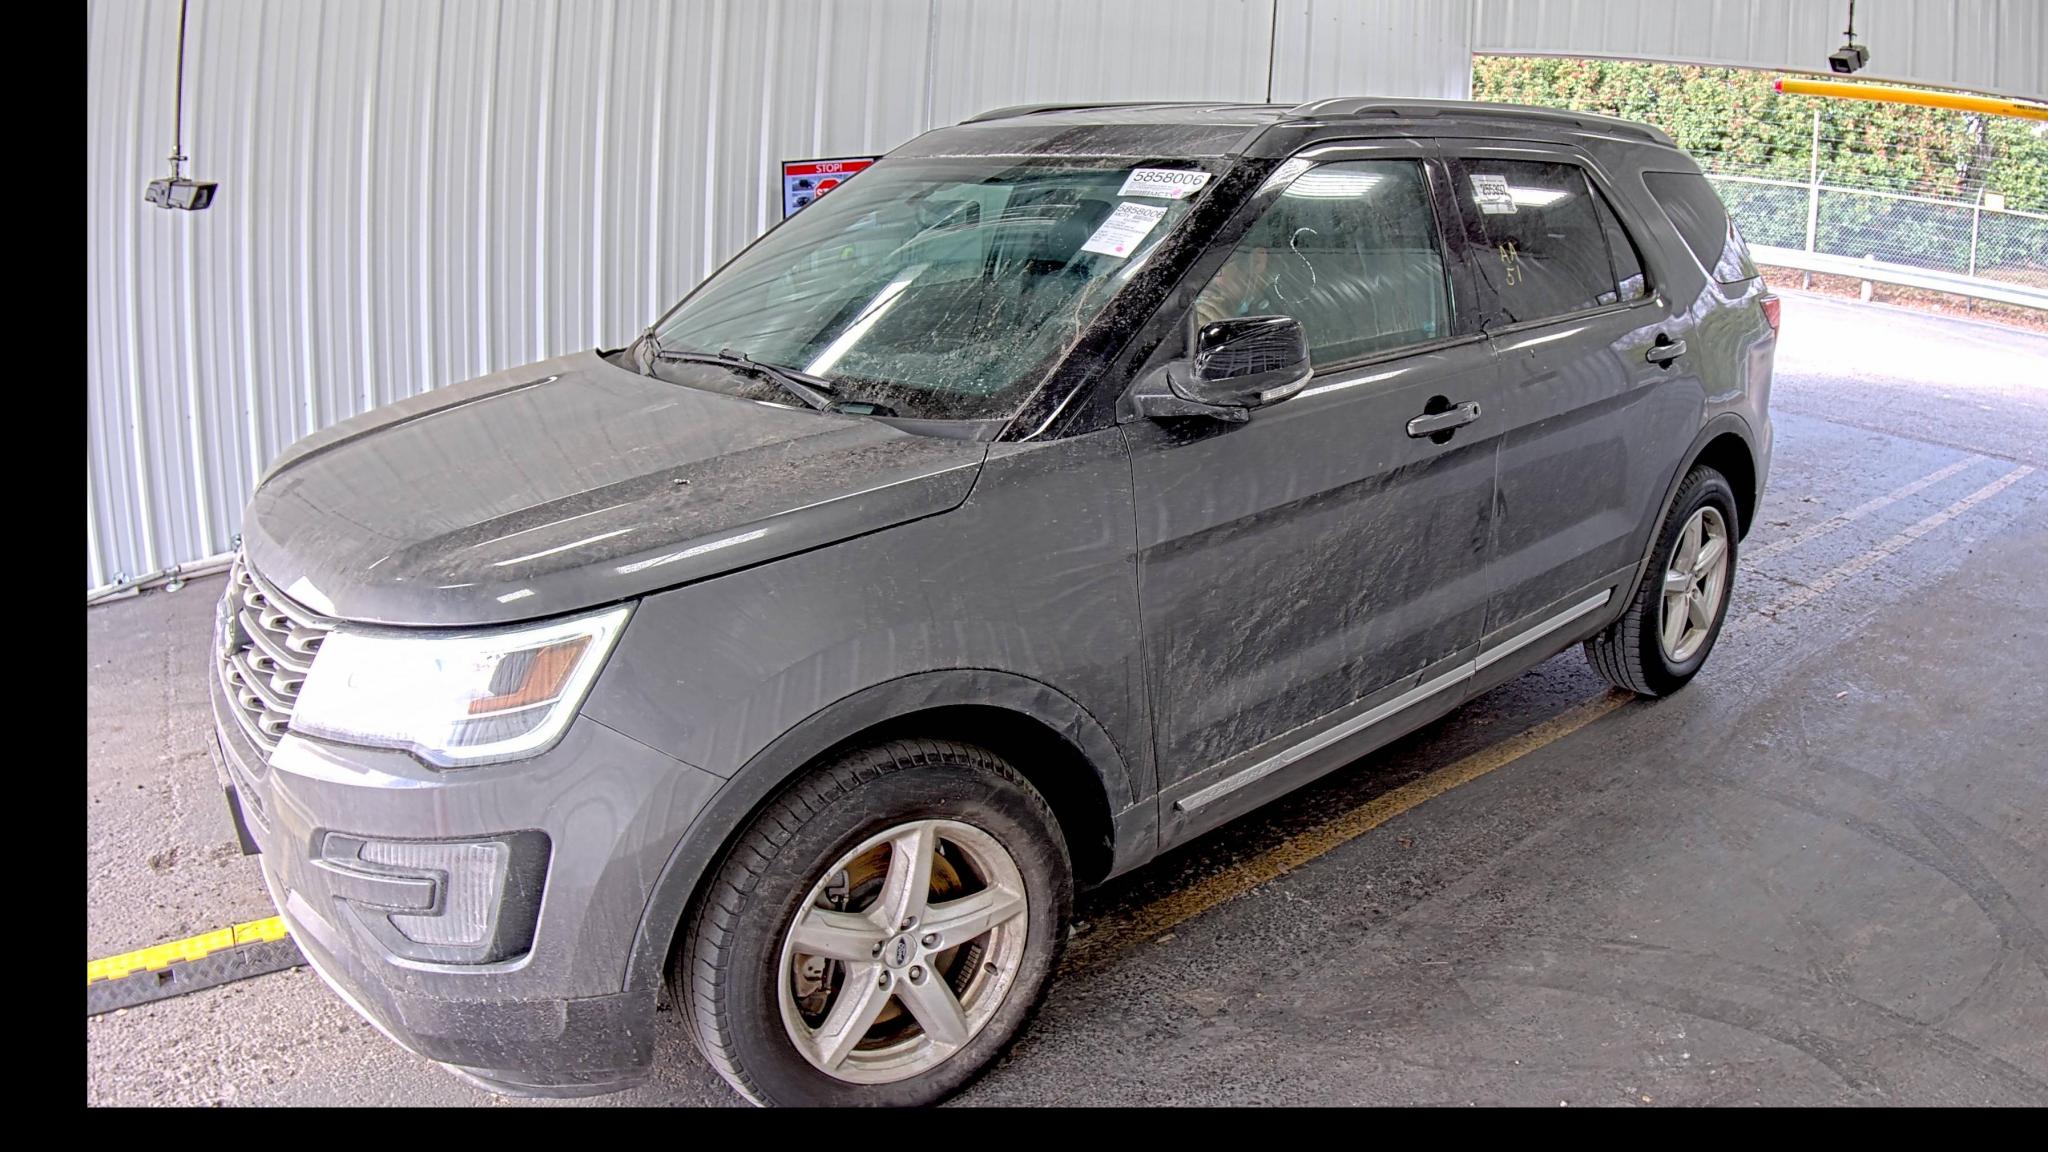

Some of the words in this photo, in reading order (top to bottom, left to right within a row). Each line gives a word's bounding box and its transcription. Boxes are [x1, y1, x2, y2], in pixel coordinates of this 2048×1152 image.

[816, 163, 842, 173] STOP!
[1133, 171, 1204, 185] 5858006
[1116, 204, 1164, 219] 5858006
[1499, 241, 1518, 263] AA
